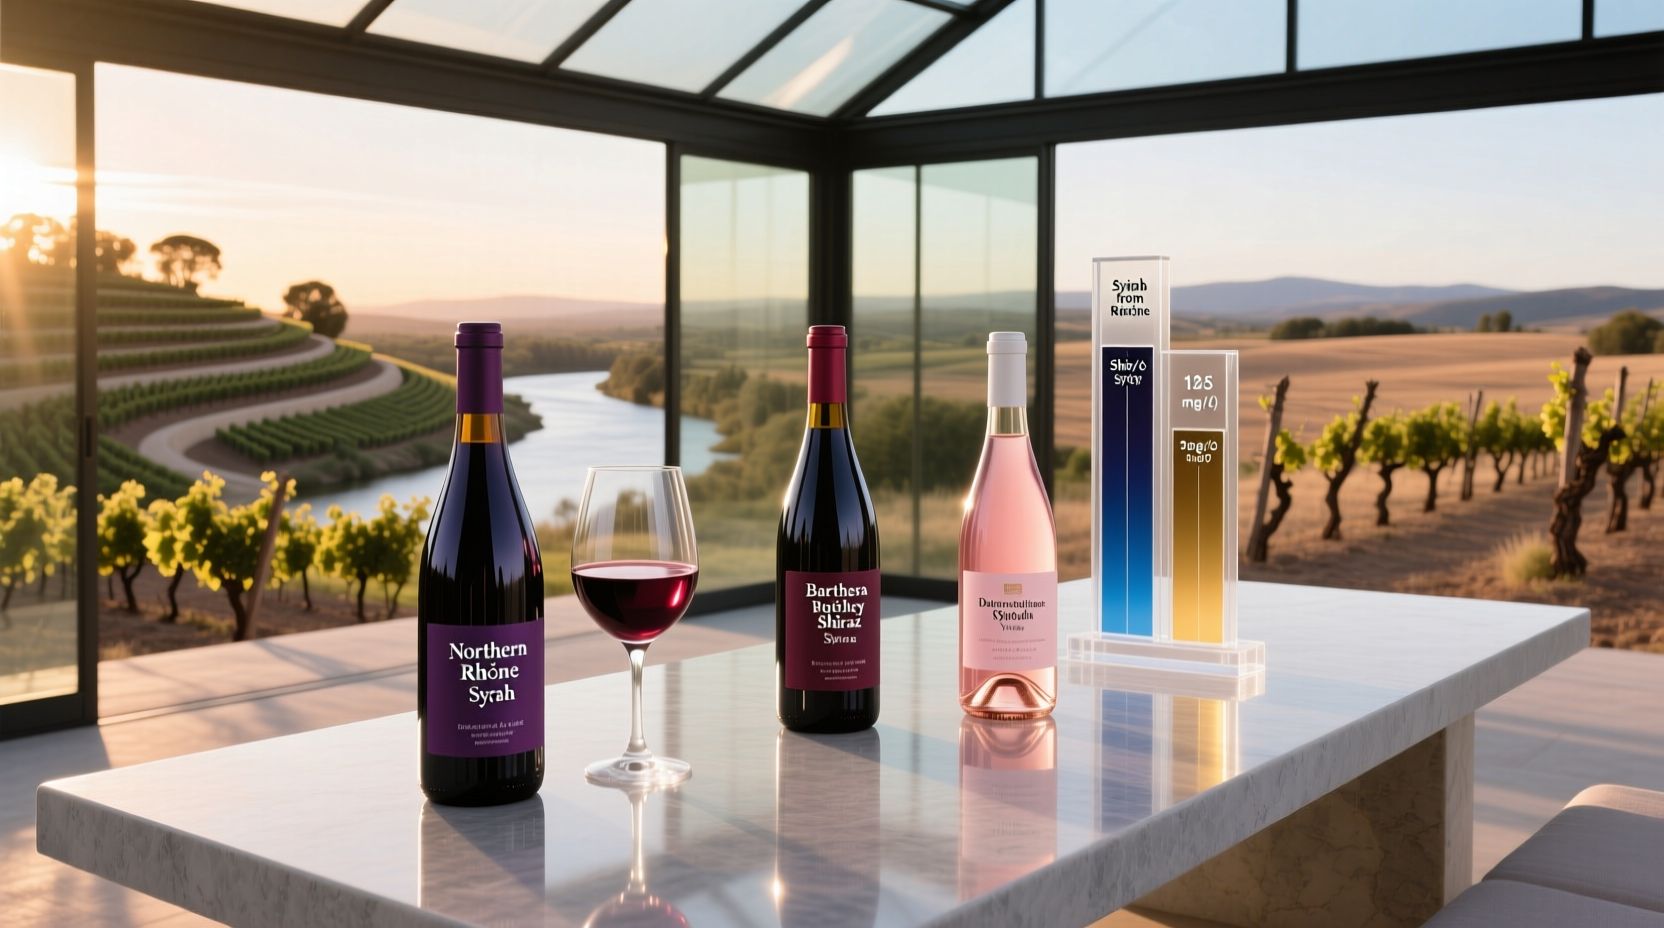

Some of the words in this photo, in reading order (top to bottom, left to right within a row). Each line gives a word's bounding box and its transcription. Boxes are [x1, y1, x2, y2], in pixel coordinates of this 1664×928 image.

[1116, 292, 1143, 303] from
[817, 613, 862, 629] Shiraz
[449, 641, 527, 660] Northern
[469, 683, 515, 708] Syrah
